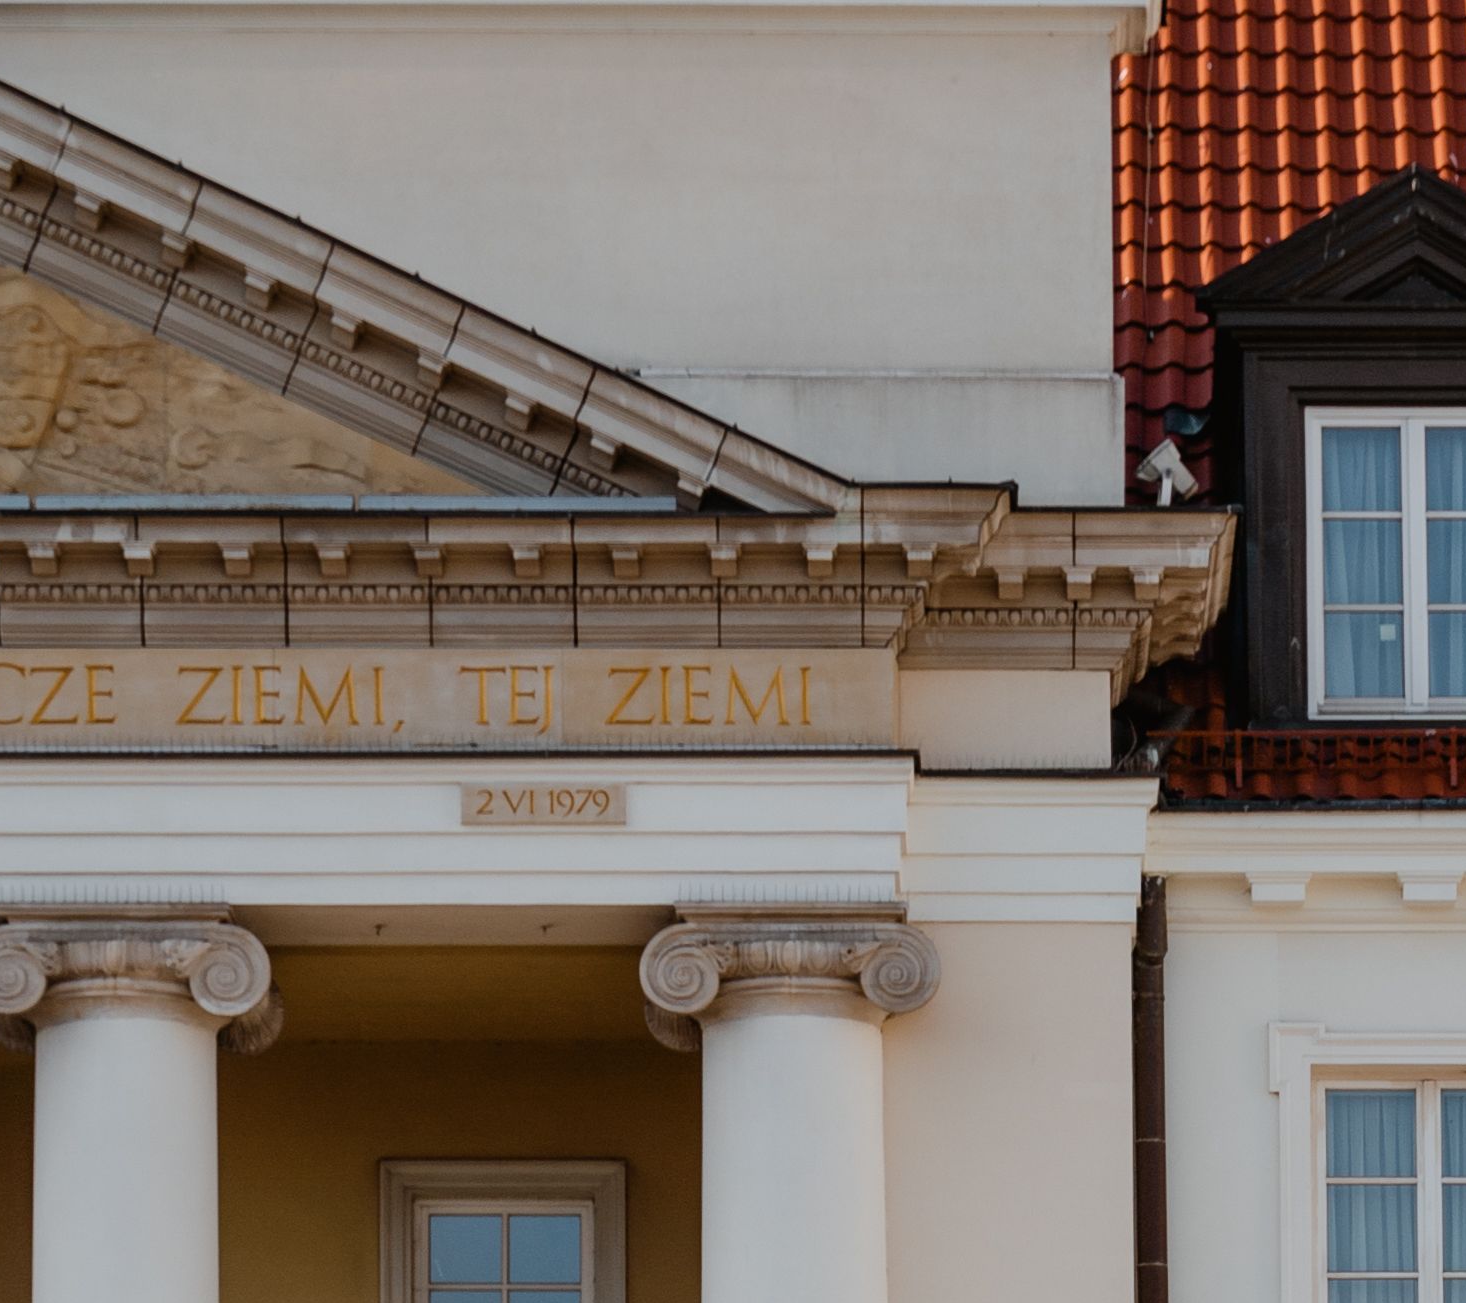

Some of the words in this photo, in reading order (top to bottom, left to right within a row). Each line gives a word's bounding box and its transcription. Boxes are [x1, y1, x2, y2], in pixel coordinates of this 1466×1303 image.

[175, 664, 406, 734] ZIEMI,
[458, 664, 556, 736] TEJ
[604, 664, 813, 727] ZIEMI
[476, 788, 494, 815] 2
[501, 788, 534, 815] VI
[547, 788, 611, 817] 1979
